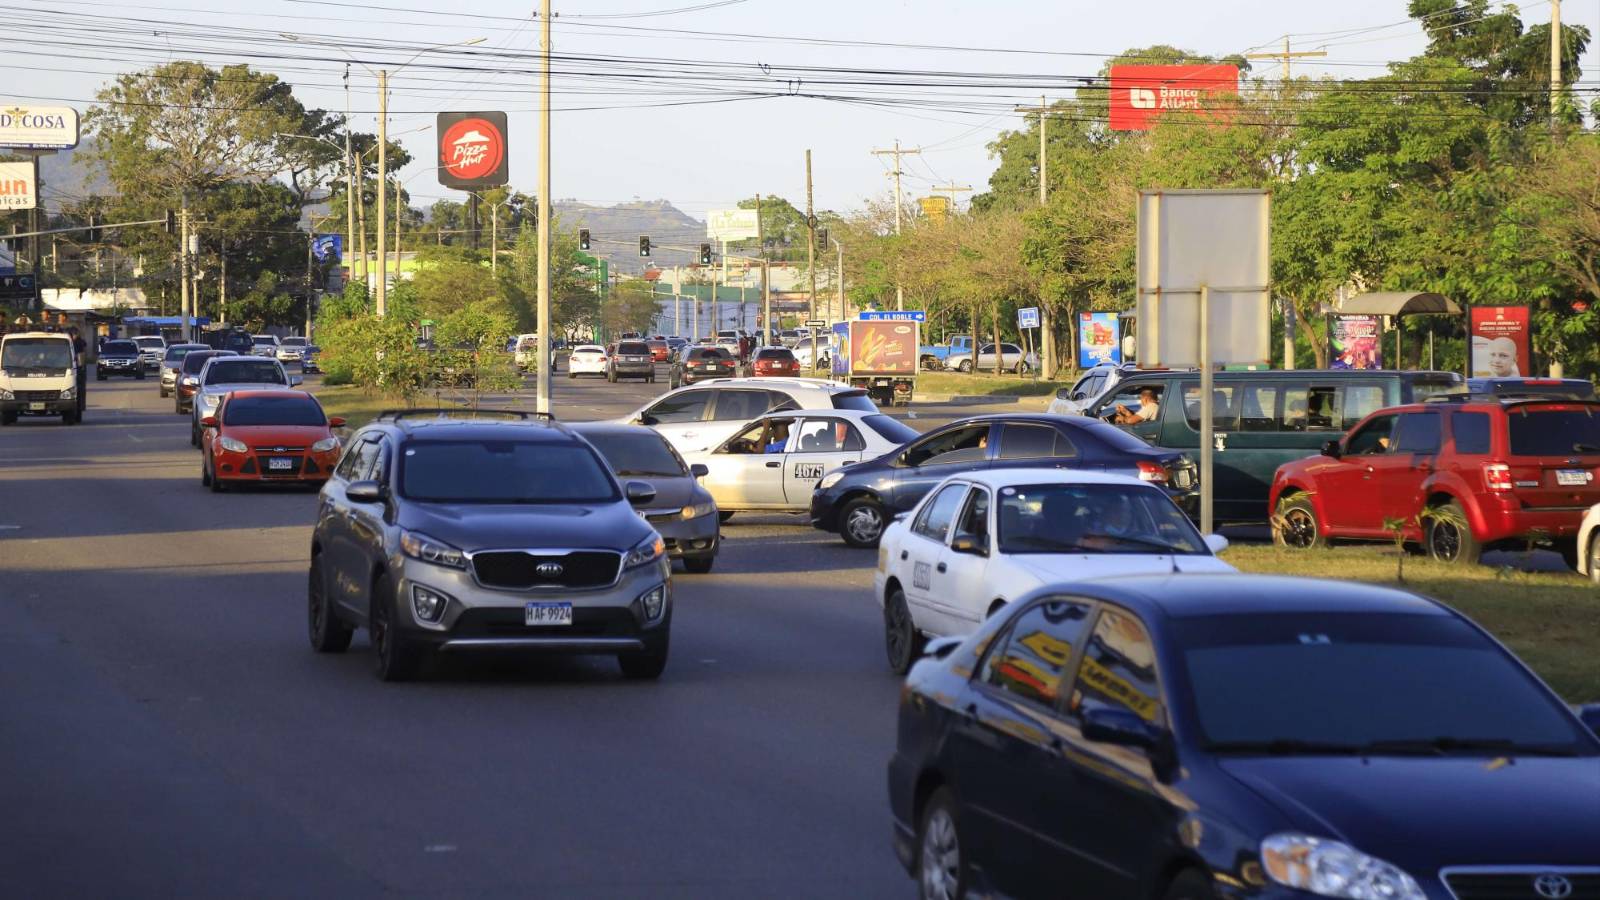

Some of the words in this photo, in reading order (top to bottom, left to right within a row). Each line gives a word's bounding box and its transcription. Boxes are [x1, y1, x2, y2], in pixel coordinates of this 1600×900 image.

[1160, 86, 1198, 97] Banco
[453, 143, 488, 160] Pizza
[459, 153, 487, 168] Hut
[795, 464, 823, 477] 4675
[540, 566, 558, 575] KIA
[548, 607, 571, 621] 9924
